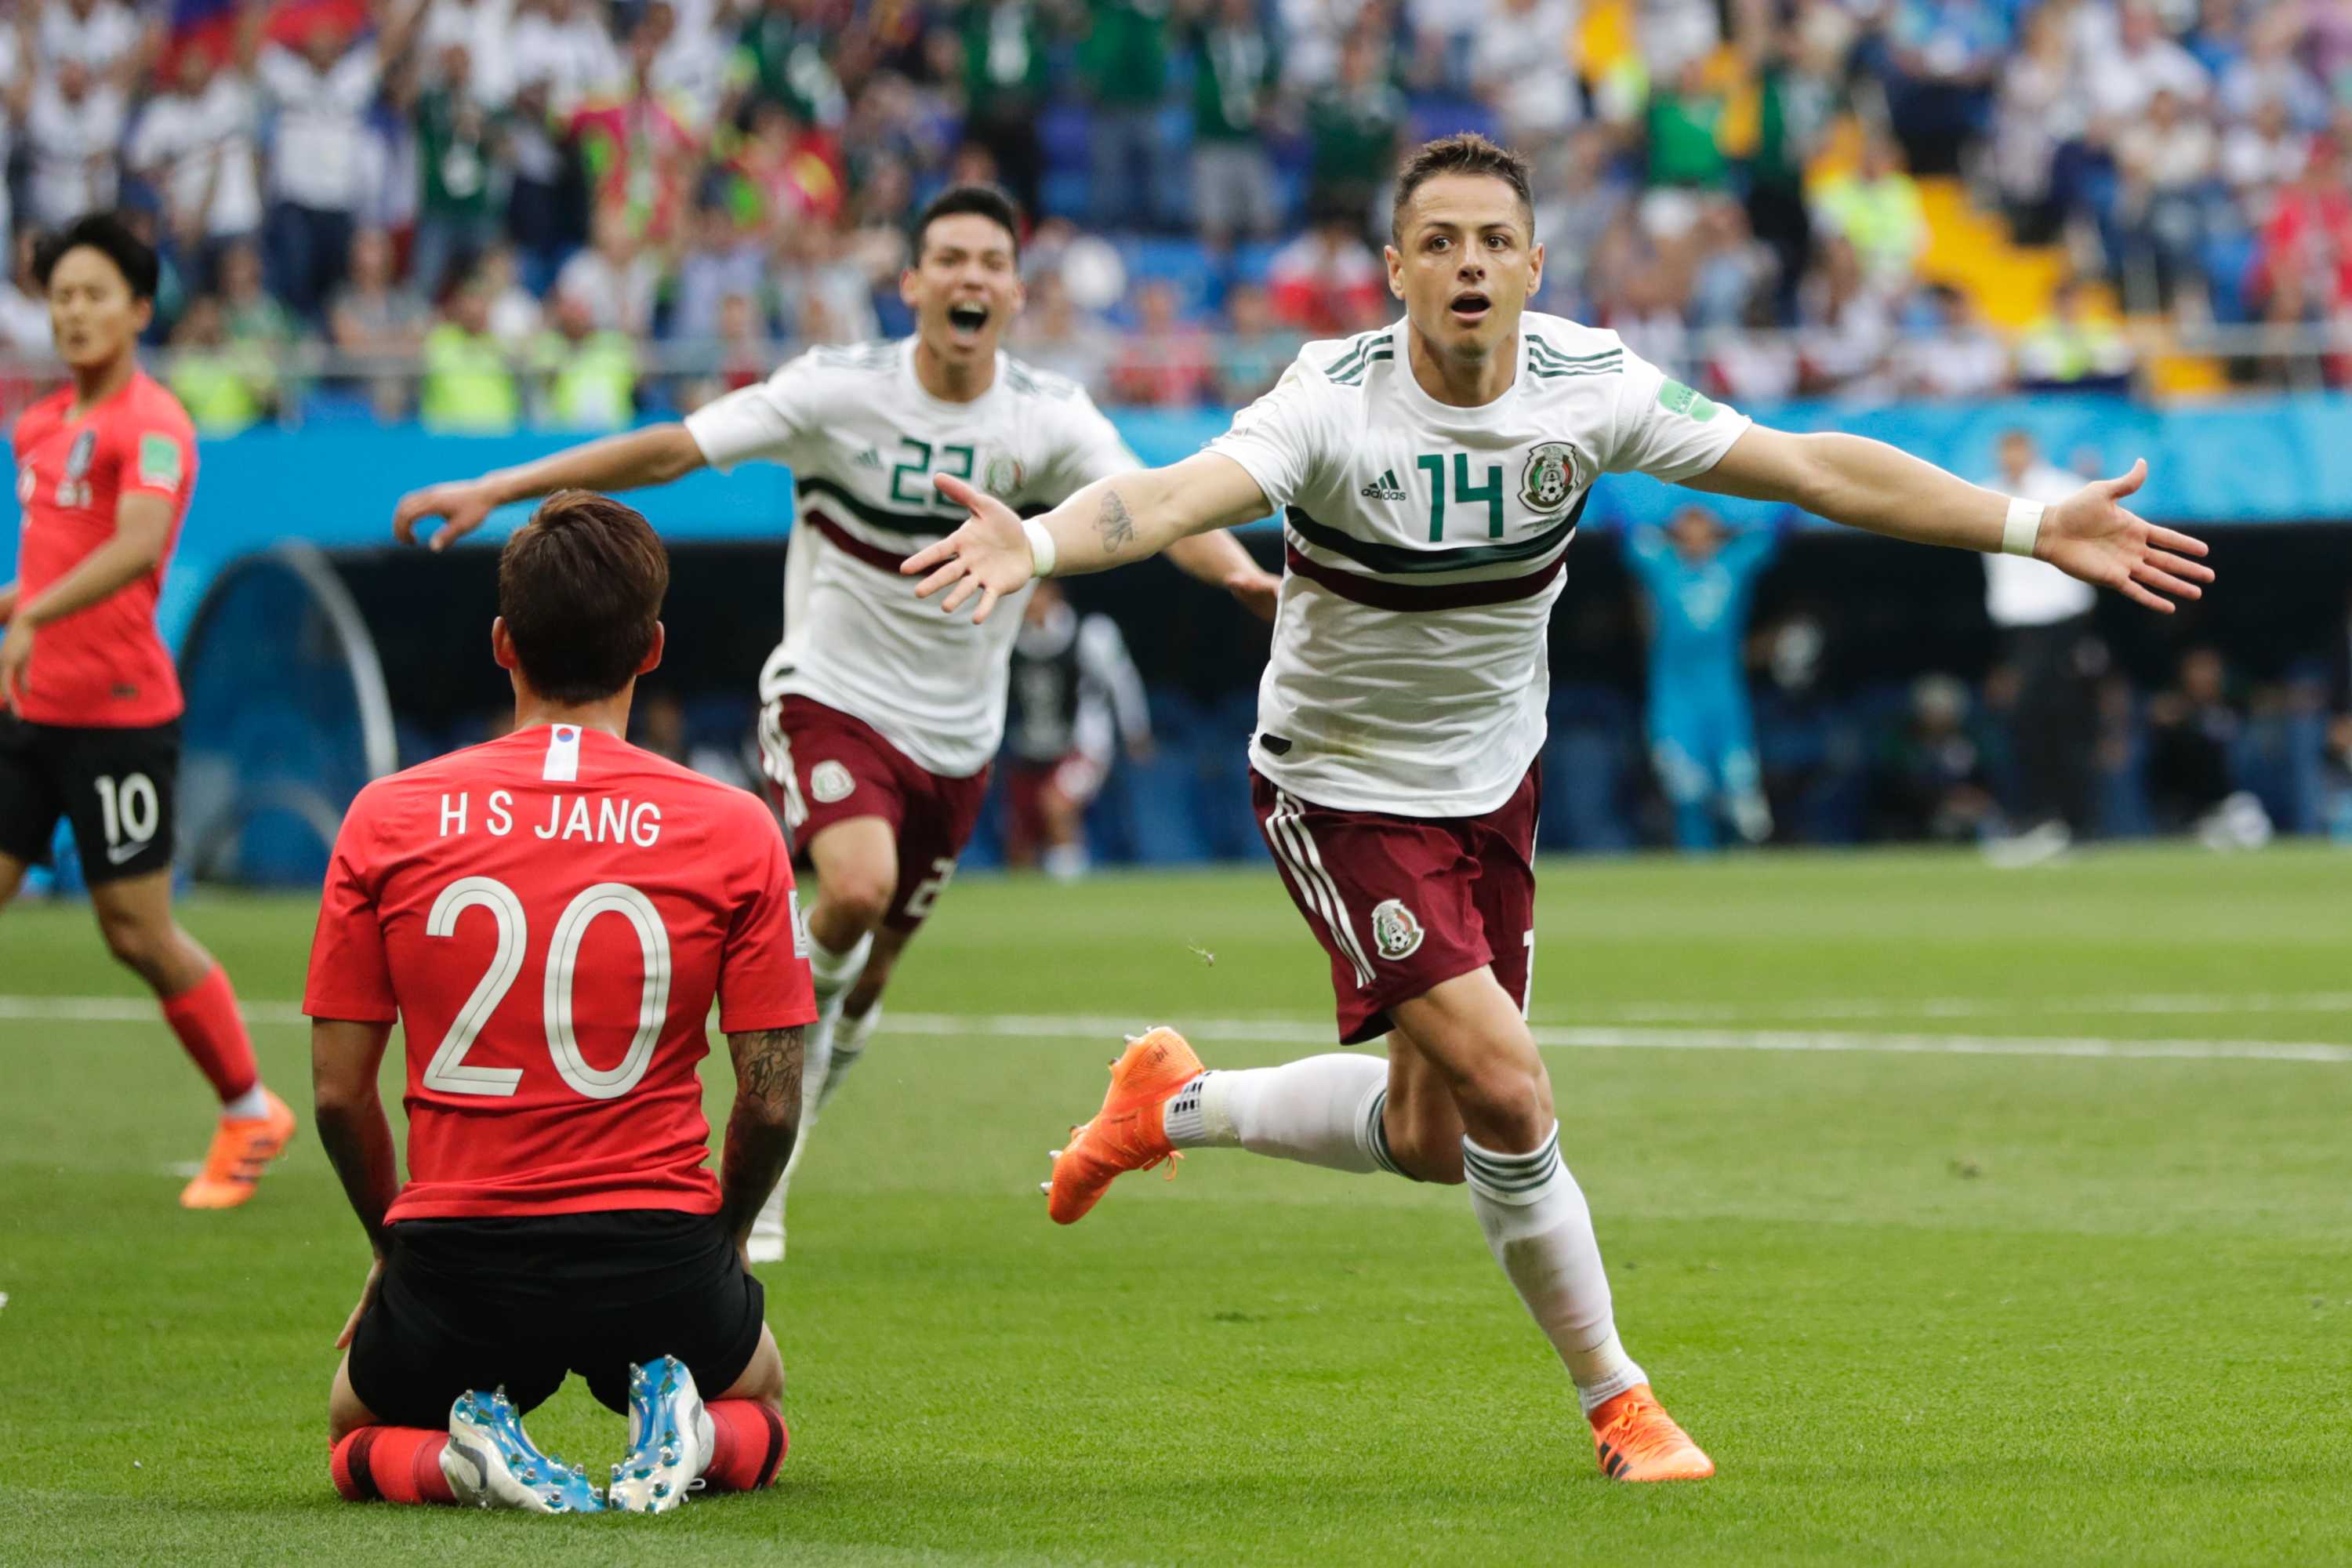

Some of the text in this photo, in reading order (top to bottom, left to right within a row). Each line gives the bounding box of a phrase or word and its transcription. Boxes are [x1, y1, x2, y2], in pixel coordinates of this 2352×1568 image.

[891, 436, 975, 508] 22
[1361, 487, 1406, 501] adidas
[1417, 453, 1503, 543] 14
[94, 771, 159, 846] 10
[439, 790, 662, 848] H S JANG
[423, 876, 671, 1099] 20
